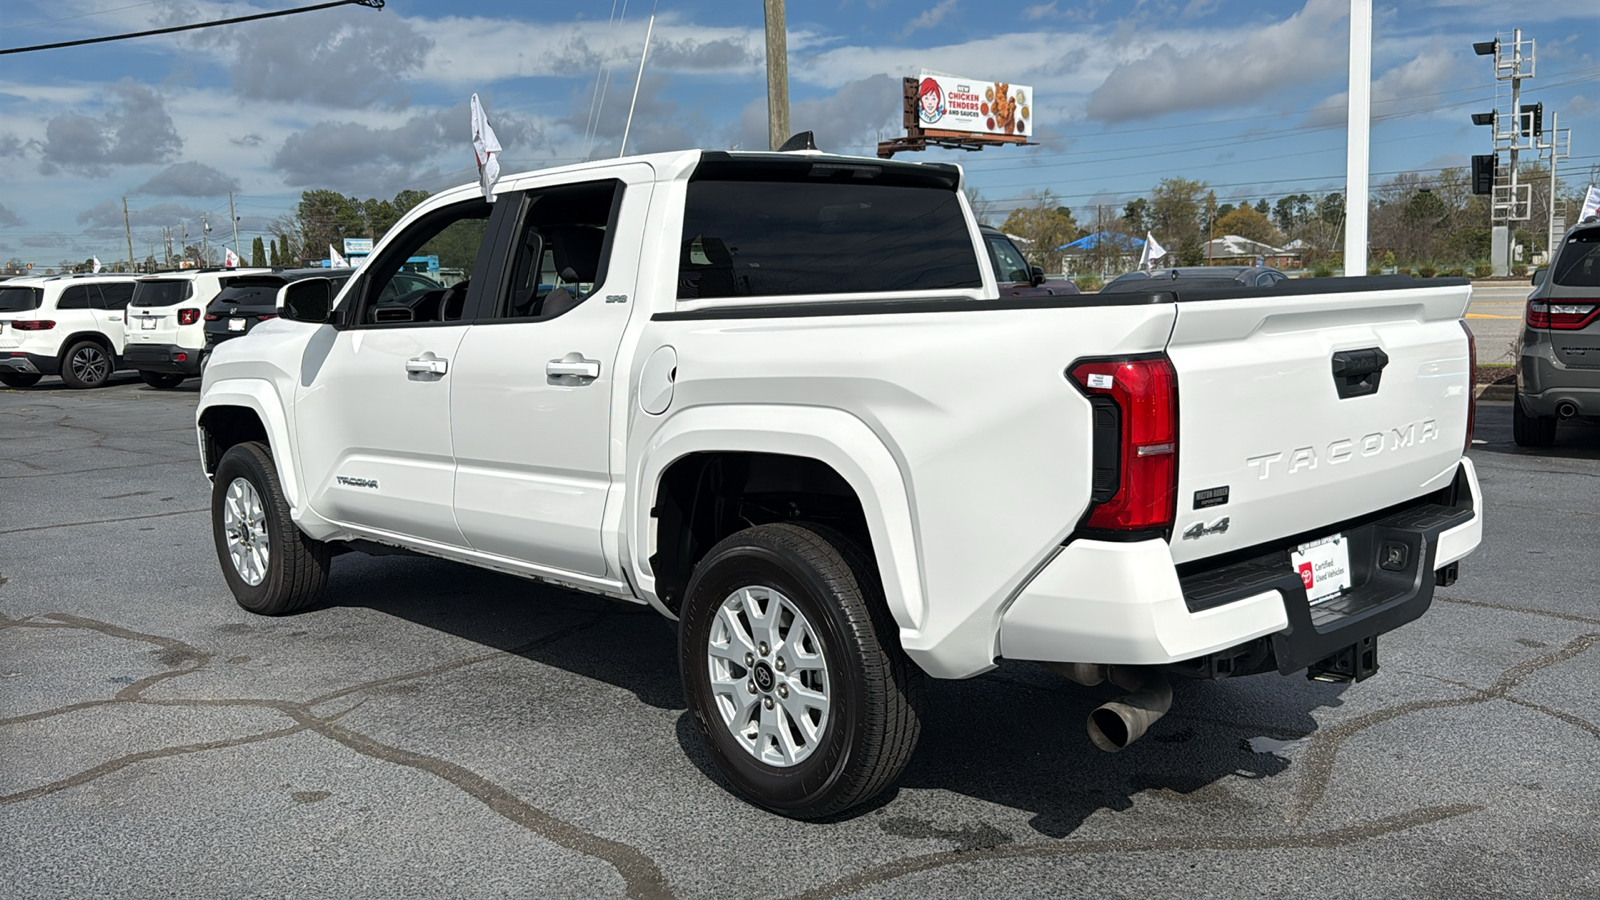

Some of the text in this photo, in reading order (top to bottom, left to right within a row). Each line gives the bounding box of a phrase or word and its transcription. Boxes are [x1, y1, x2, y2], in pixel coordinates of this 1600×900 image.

[948, 92, 979, 102] CHICKEN
[948, 101, 979, 110] TENDERS
[1246, 419, 1439, 480] TACOMA
[336, 476, 379, 489] TACOMA
[1314, 558, 1334, 571] Certified
[1315, 567, 1345, 583] Used Vehicles
